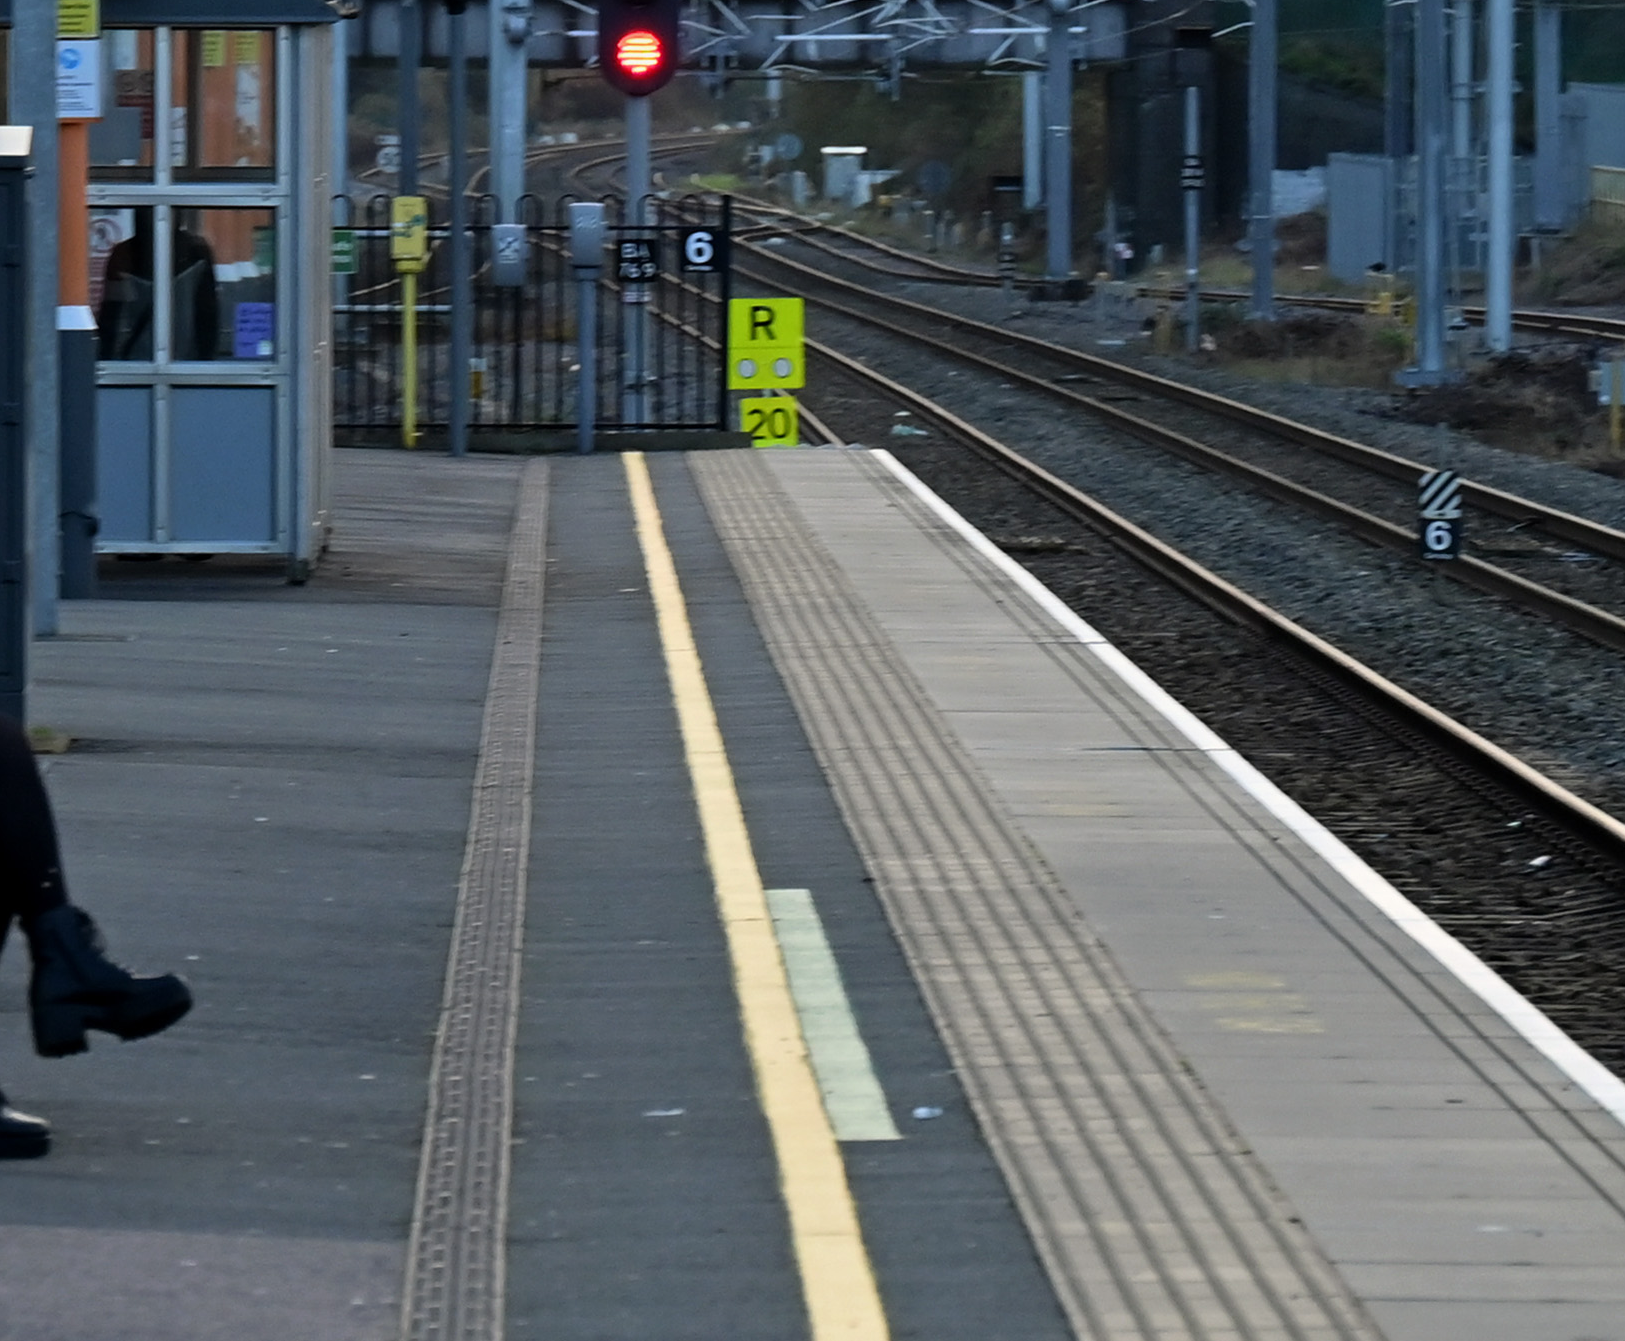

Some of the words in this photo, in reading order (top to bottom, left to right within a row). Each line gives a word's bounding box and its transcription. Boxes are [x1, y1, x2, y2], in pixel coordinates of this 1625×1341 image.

[685, 231, 714, 264] 6
[749, 305, 776, 341] R
[747, 408, 791, 440] 20
[1425, 520, 1452, 551] 6
